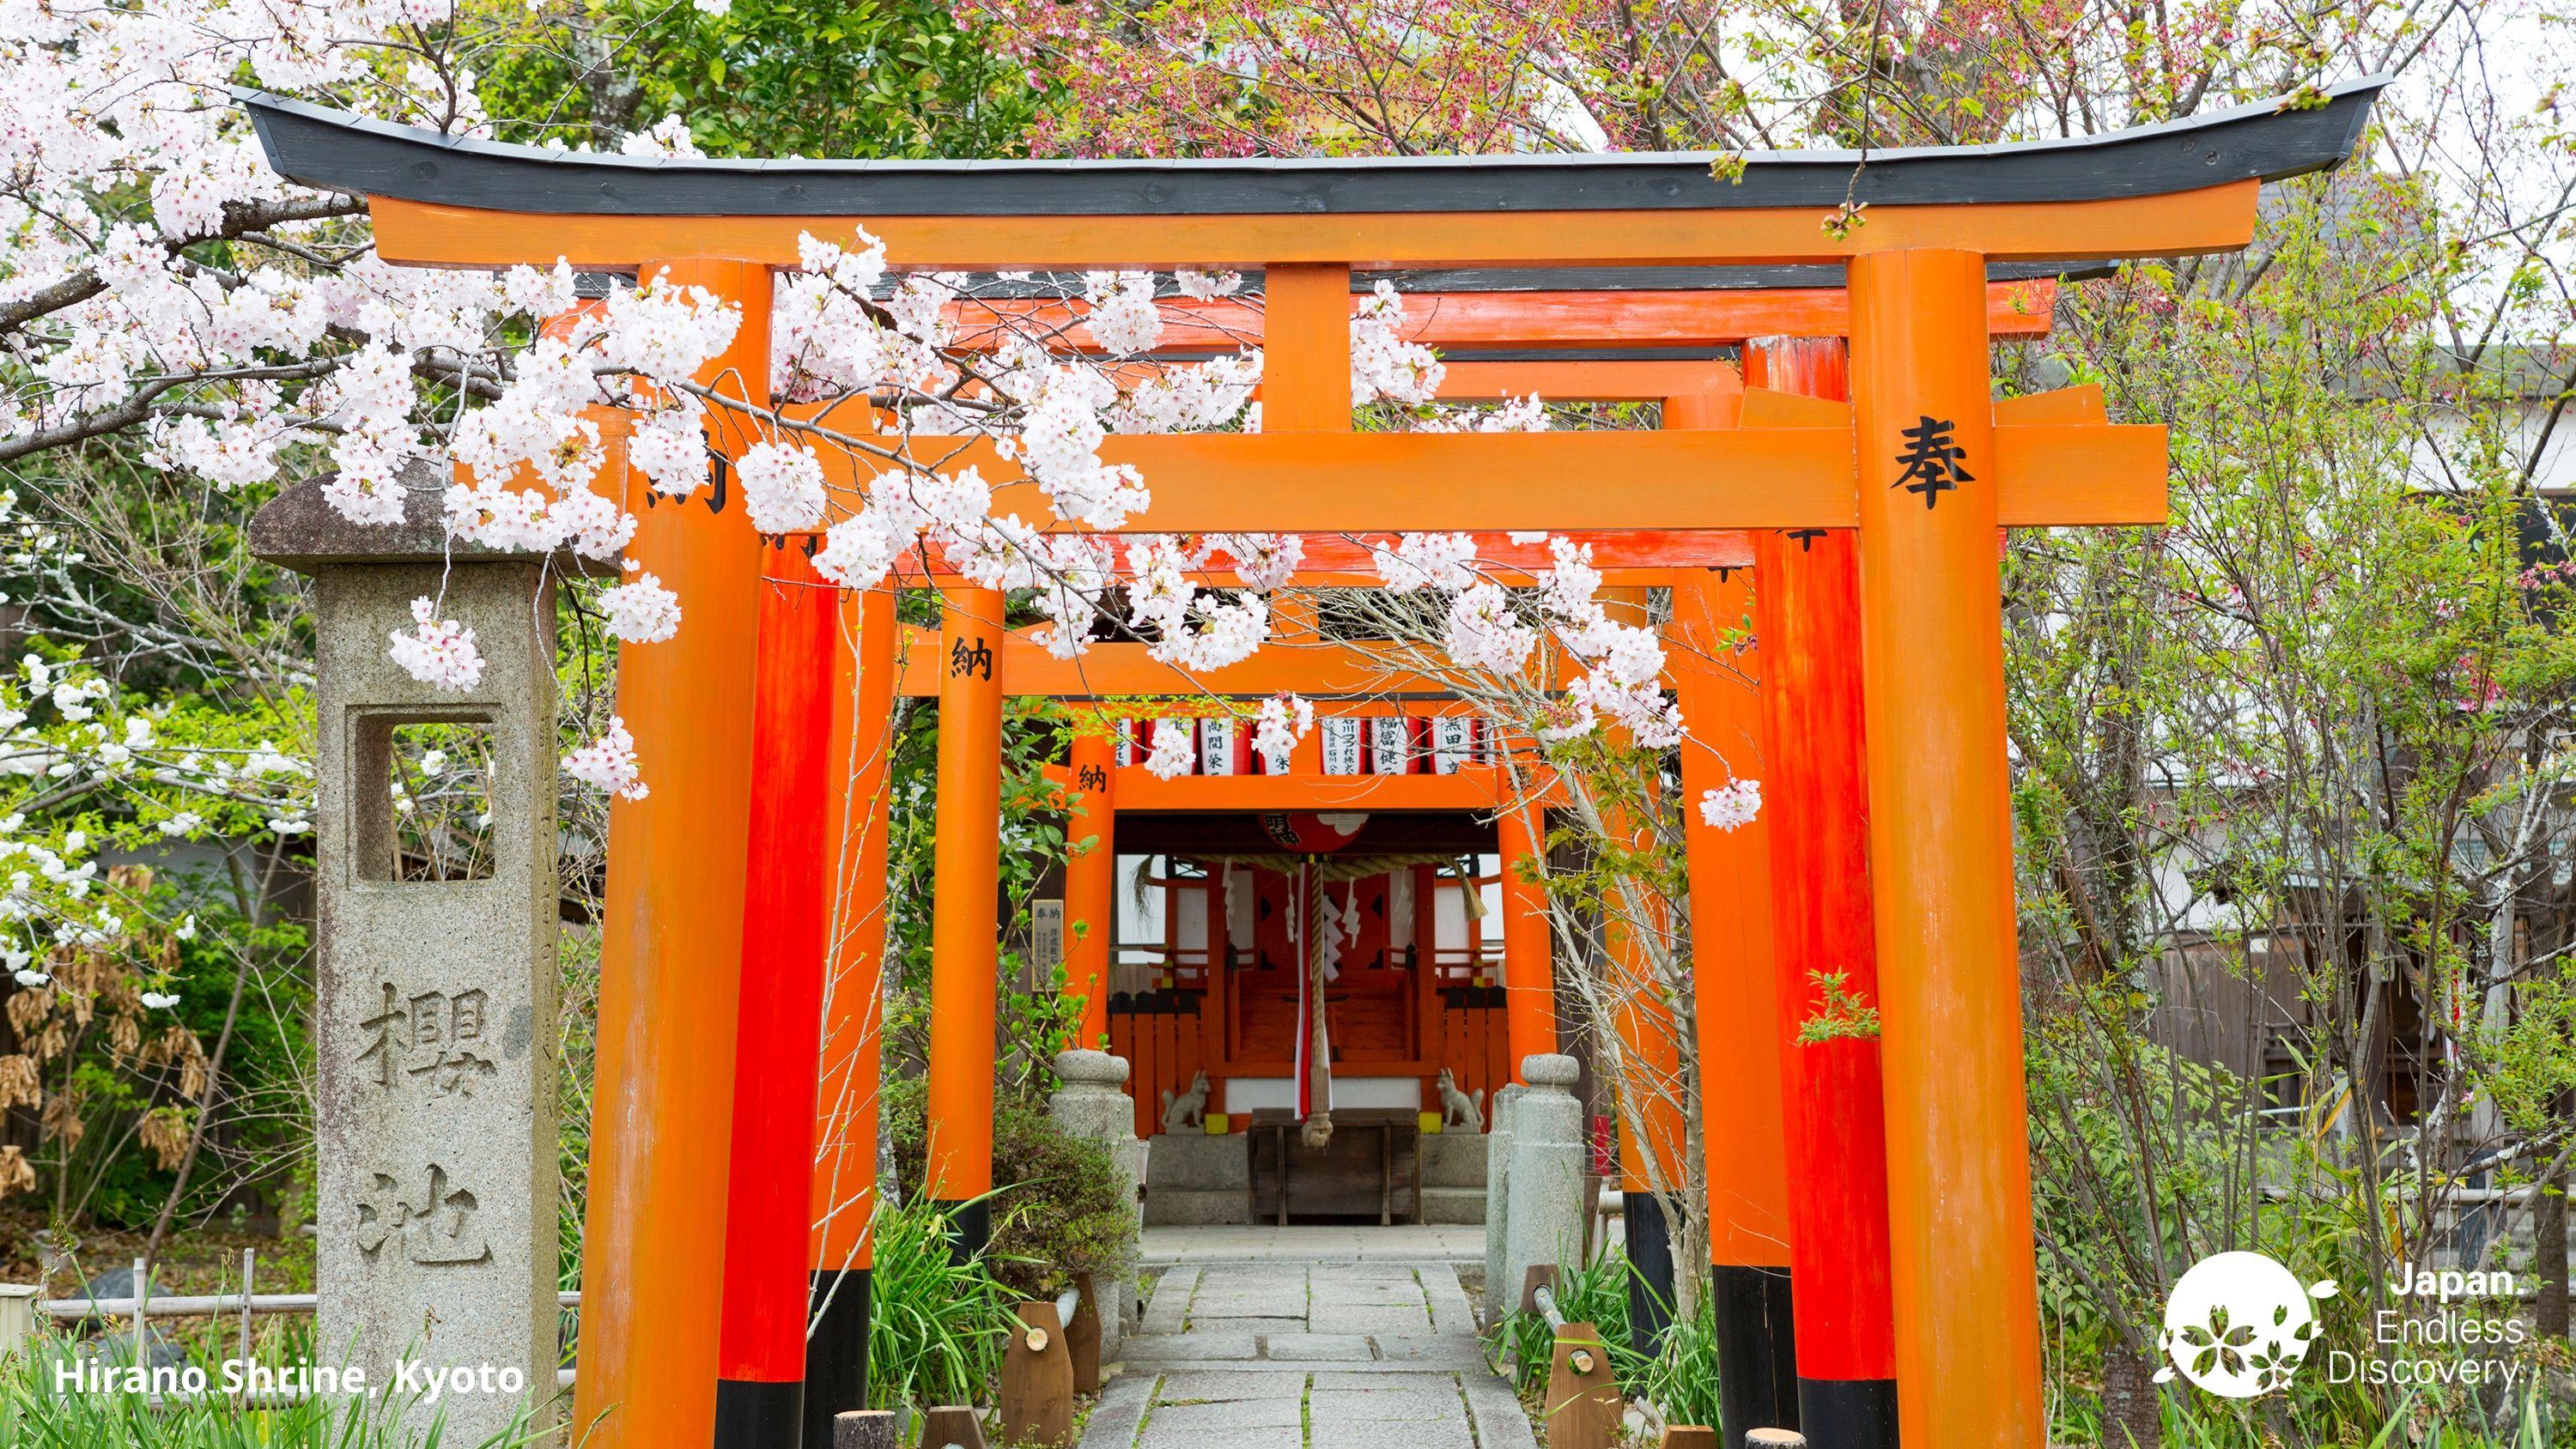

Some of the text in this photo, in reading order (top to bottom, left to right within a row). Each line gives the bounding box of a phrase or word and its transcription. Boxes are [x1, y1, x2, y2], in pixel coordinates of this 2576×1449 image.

[1889, 415, 1976, 511] 奉
[950, 636, 993, 682] 納
[1078, 763, 1107, 793] 納
